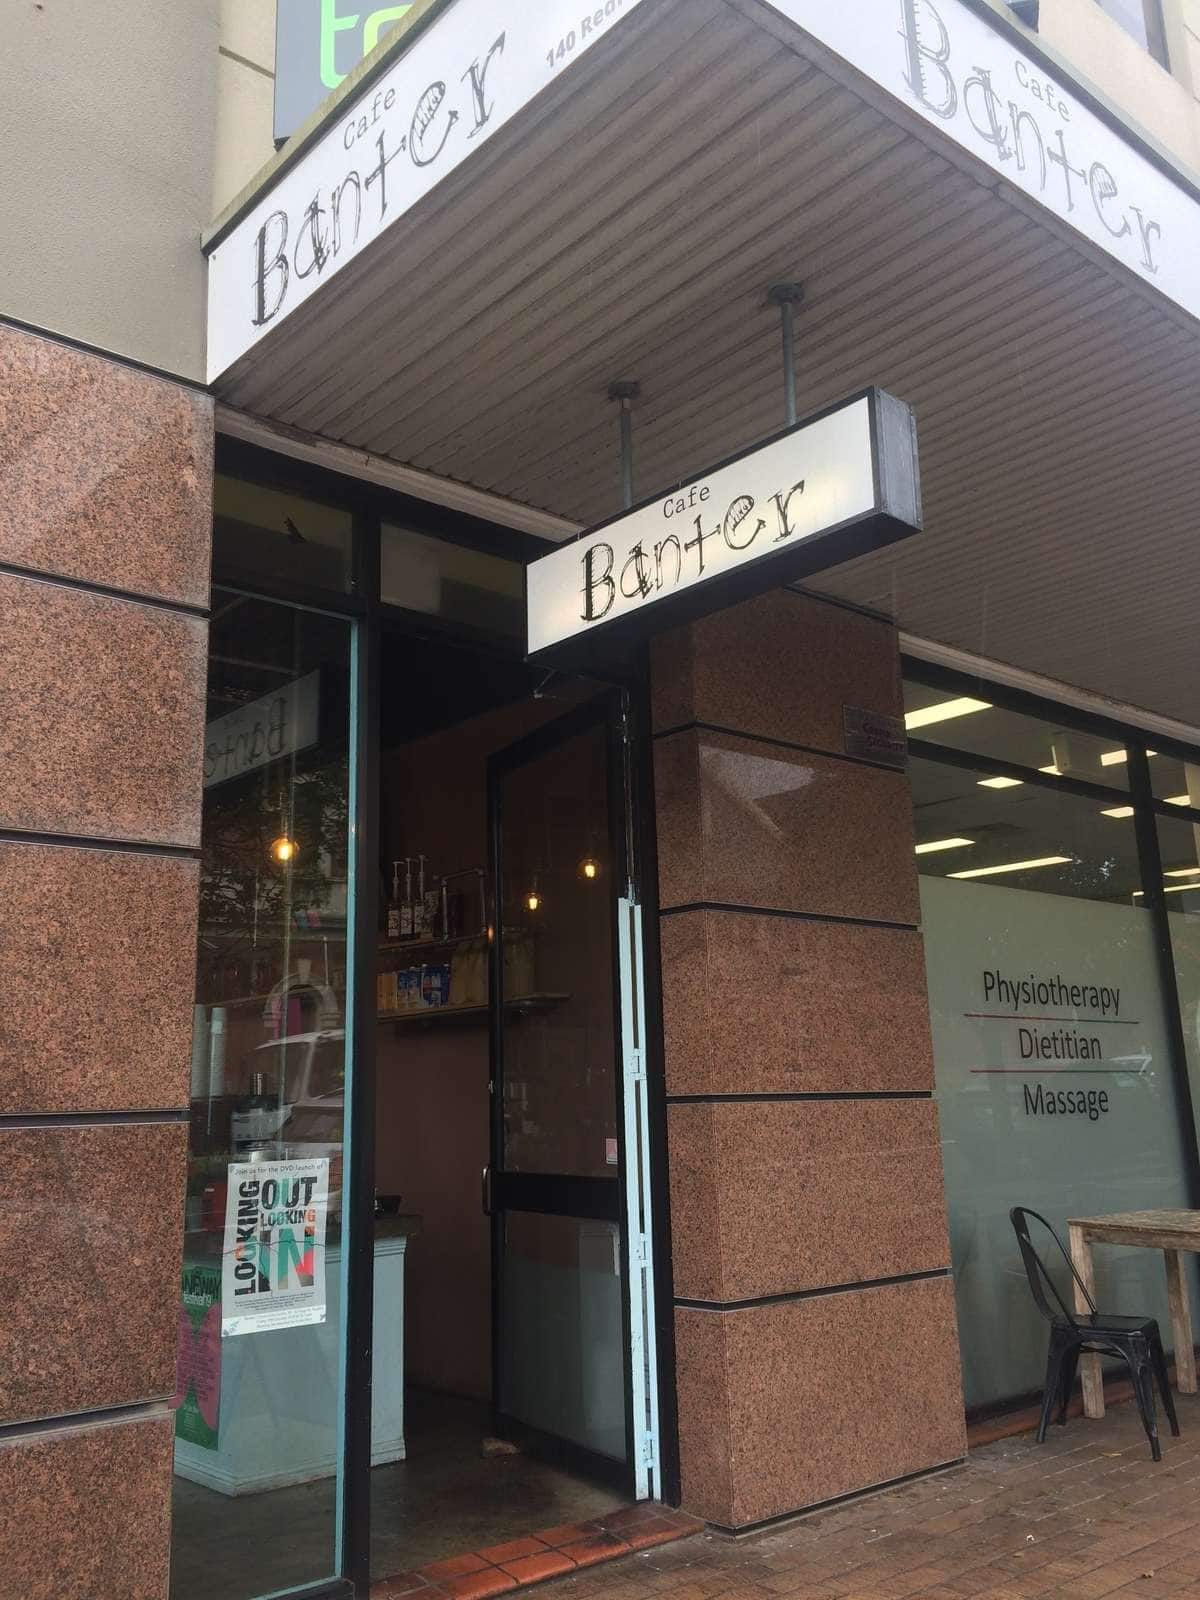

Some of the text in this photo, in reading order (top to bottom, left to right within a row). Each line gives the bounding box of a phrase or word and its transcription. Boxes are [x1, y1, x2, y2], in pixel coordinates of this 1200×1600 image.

[546, 30, 576, 68] 140
[1014, 60, 1071, 122] Cafe
[343, 87, 396, 150] Cafe
[897, 0, 1161, 274] Banter
[252, 30, 506, 327] Banter
[662, 485, 711, 519] Cafe
[579, 479, 806, 623] Banter
[983, 970, 1120, 1016] Physiotherapy
[1018, 1027, 1102, 1060] Dietitian
[1023, 1083, 1109, 1121] Massage
[260, 1208, 317, 1227] LOOKING
[261, 1176, 318, 1210] OUT
[234, 1180, 260, 1297] LOOKING
[258, 1226, 315, 1293] IN
